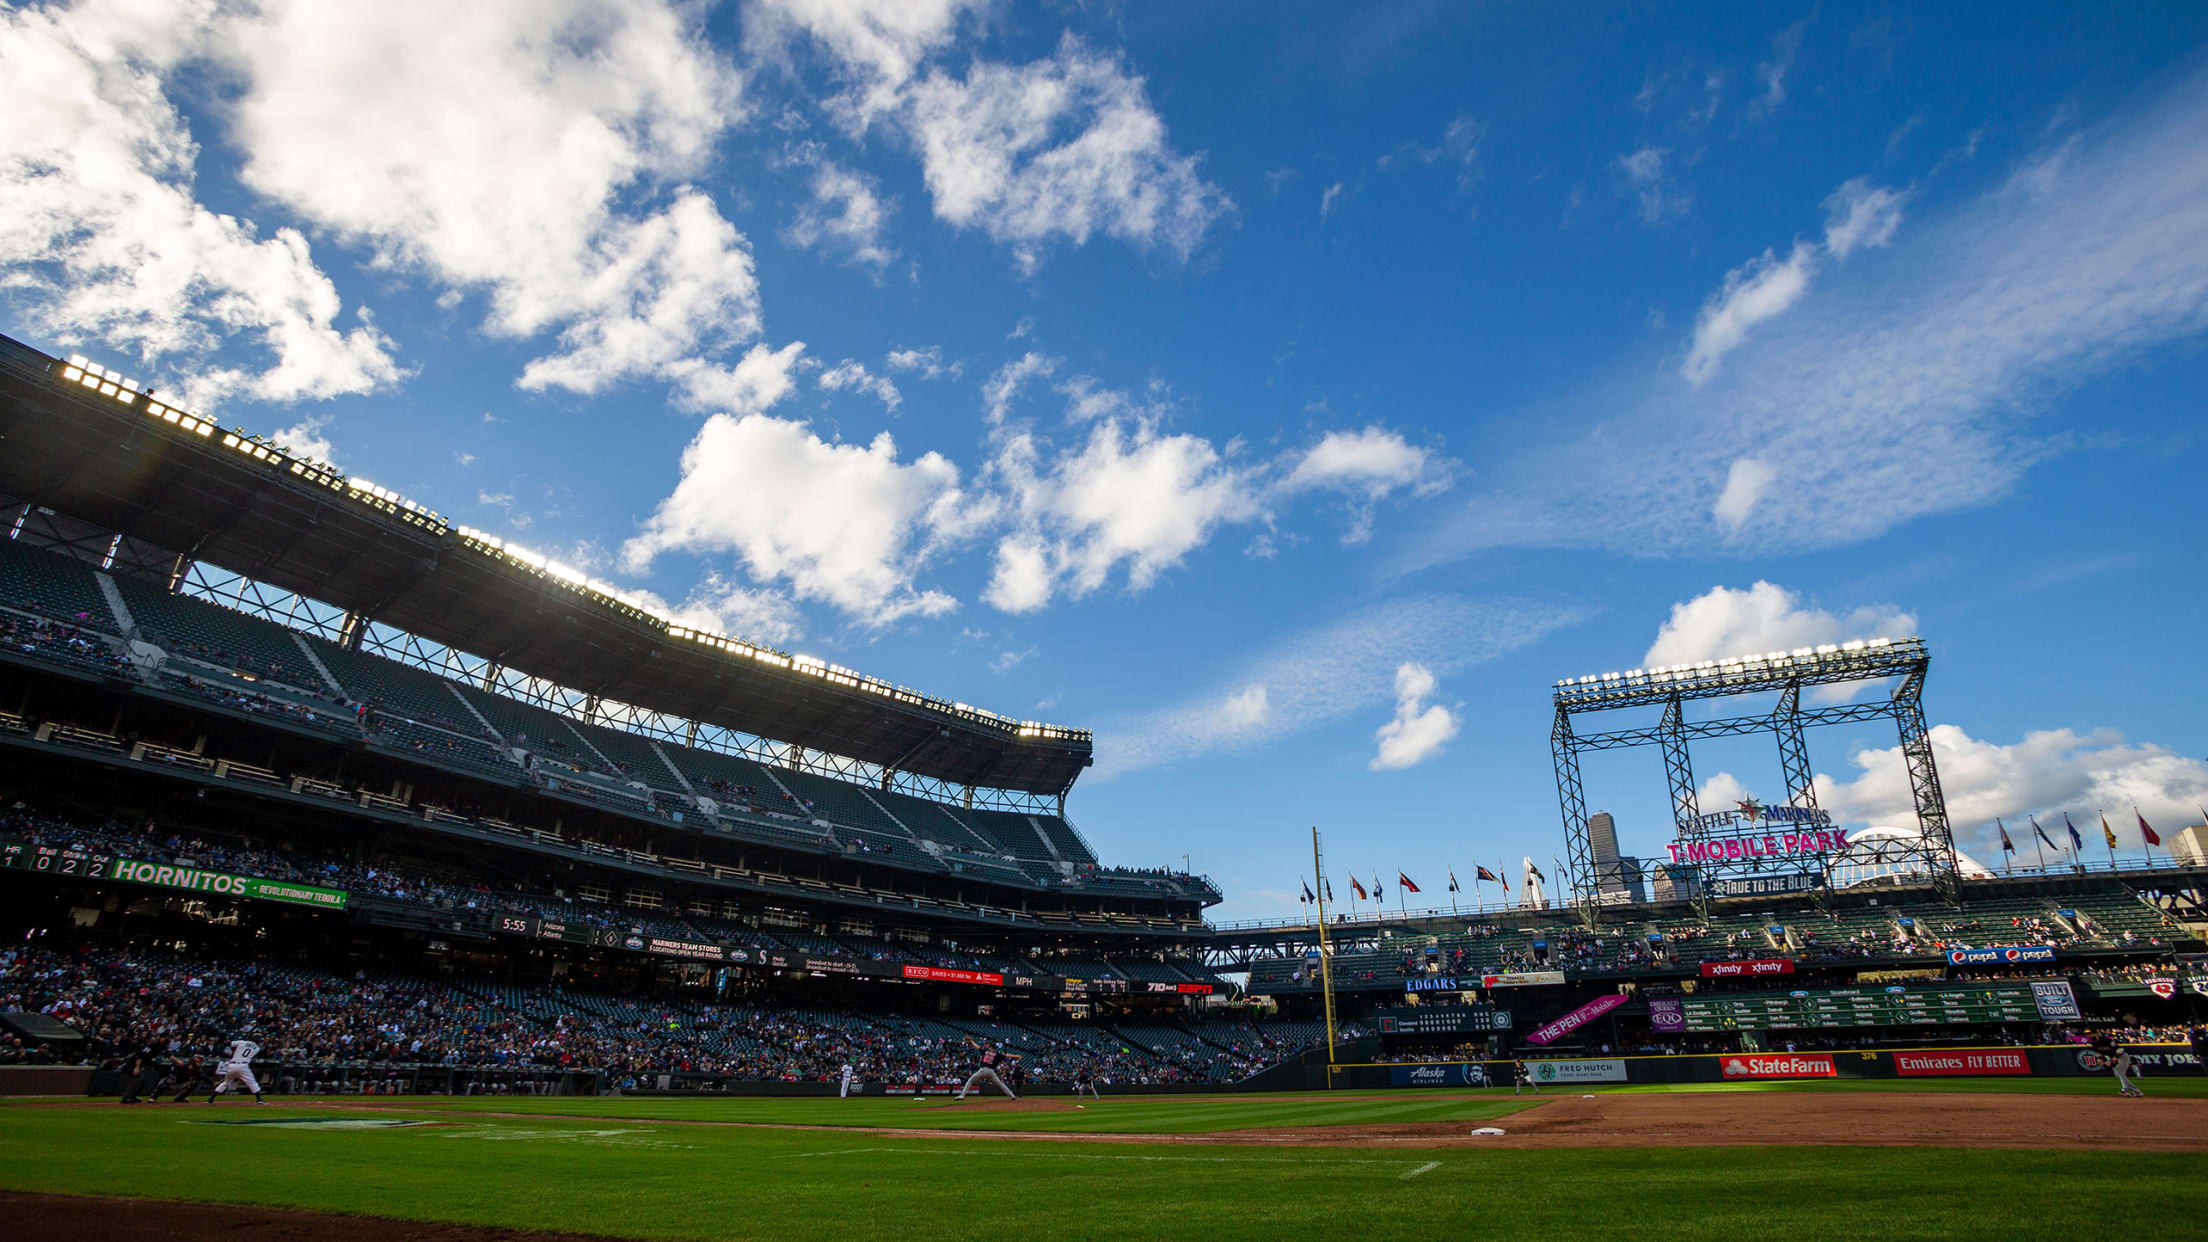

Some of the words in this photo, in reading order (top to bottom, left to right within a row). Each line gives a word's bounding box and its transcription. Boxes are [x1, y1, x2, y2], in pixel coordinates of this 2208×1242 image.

[1678, 810, 1734, 836] SEATTLE
[1765, 804, 1832, 824] MARINERS
[1784, 829, 1852, 853] PARK
[5, 845, 22, 854] HR
[37, 857, 50, 870] 0
[63, 860, 77, 874] 2
[90, 864, 104, 876] 2
[115, 861, 247, 895] HORNITOS
[1726, 879, 1750, 894] TRUE
[1752, 879, 1764, 892] TO
[1767, 878, 1786, 890] THE
[1788, 876, 1813, 890] BLUE
[259, 884, 313, 900] REVOLUTIONARY
[314, 892, 341, 904] TEQUILA
[503, 918, 526, 932] 5:55
[652, 939, 680, 948] MARINERS
[682, 942, 698, 950] TEAM
[699, 944, 722, 953] STORES
[654, 946, 678, 955] LOCATIONS
[1968, 952, 1998, 962] pepsi
[2022, 949, 2053, 960] pepsi
[1712, 964, 1742, 974] xfinity
[1752, 962, 1782, 972] xfinity
[1016, 977, 1032, 986] MPH
[1406, 978, 1456, 992] EDGARS
[1148, 983, 1166, 992] 710
[1177, 984, 1213, 994] ESPN
[2036, 986, 2066, 996] BUILT
[2156, 984, 2170, 992] 42
[2042, 1006, 2074, 1015] TOUGH
[1654, 1013, 1681, 1024] EQC
[1538, 1024, 1560, 1042] THE
[242, 1048, 251, 1057] 0
[1900, 1056, 1963, 1069] Emirates
[1968, 1056, 1983, 1068] FLY
[1986, 1055, 2020, 1068] BETTER
[1410, 1066, 1446, 1078] Alaska
